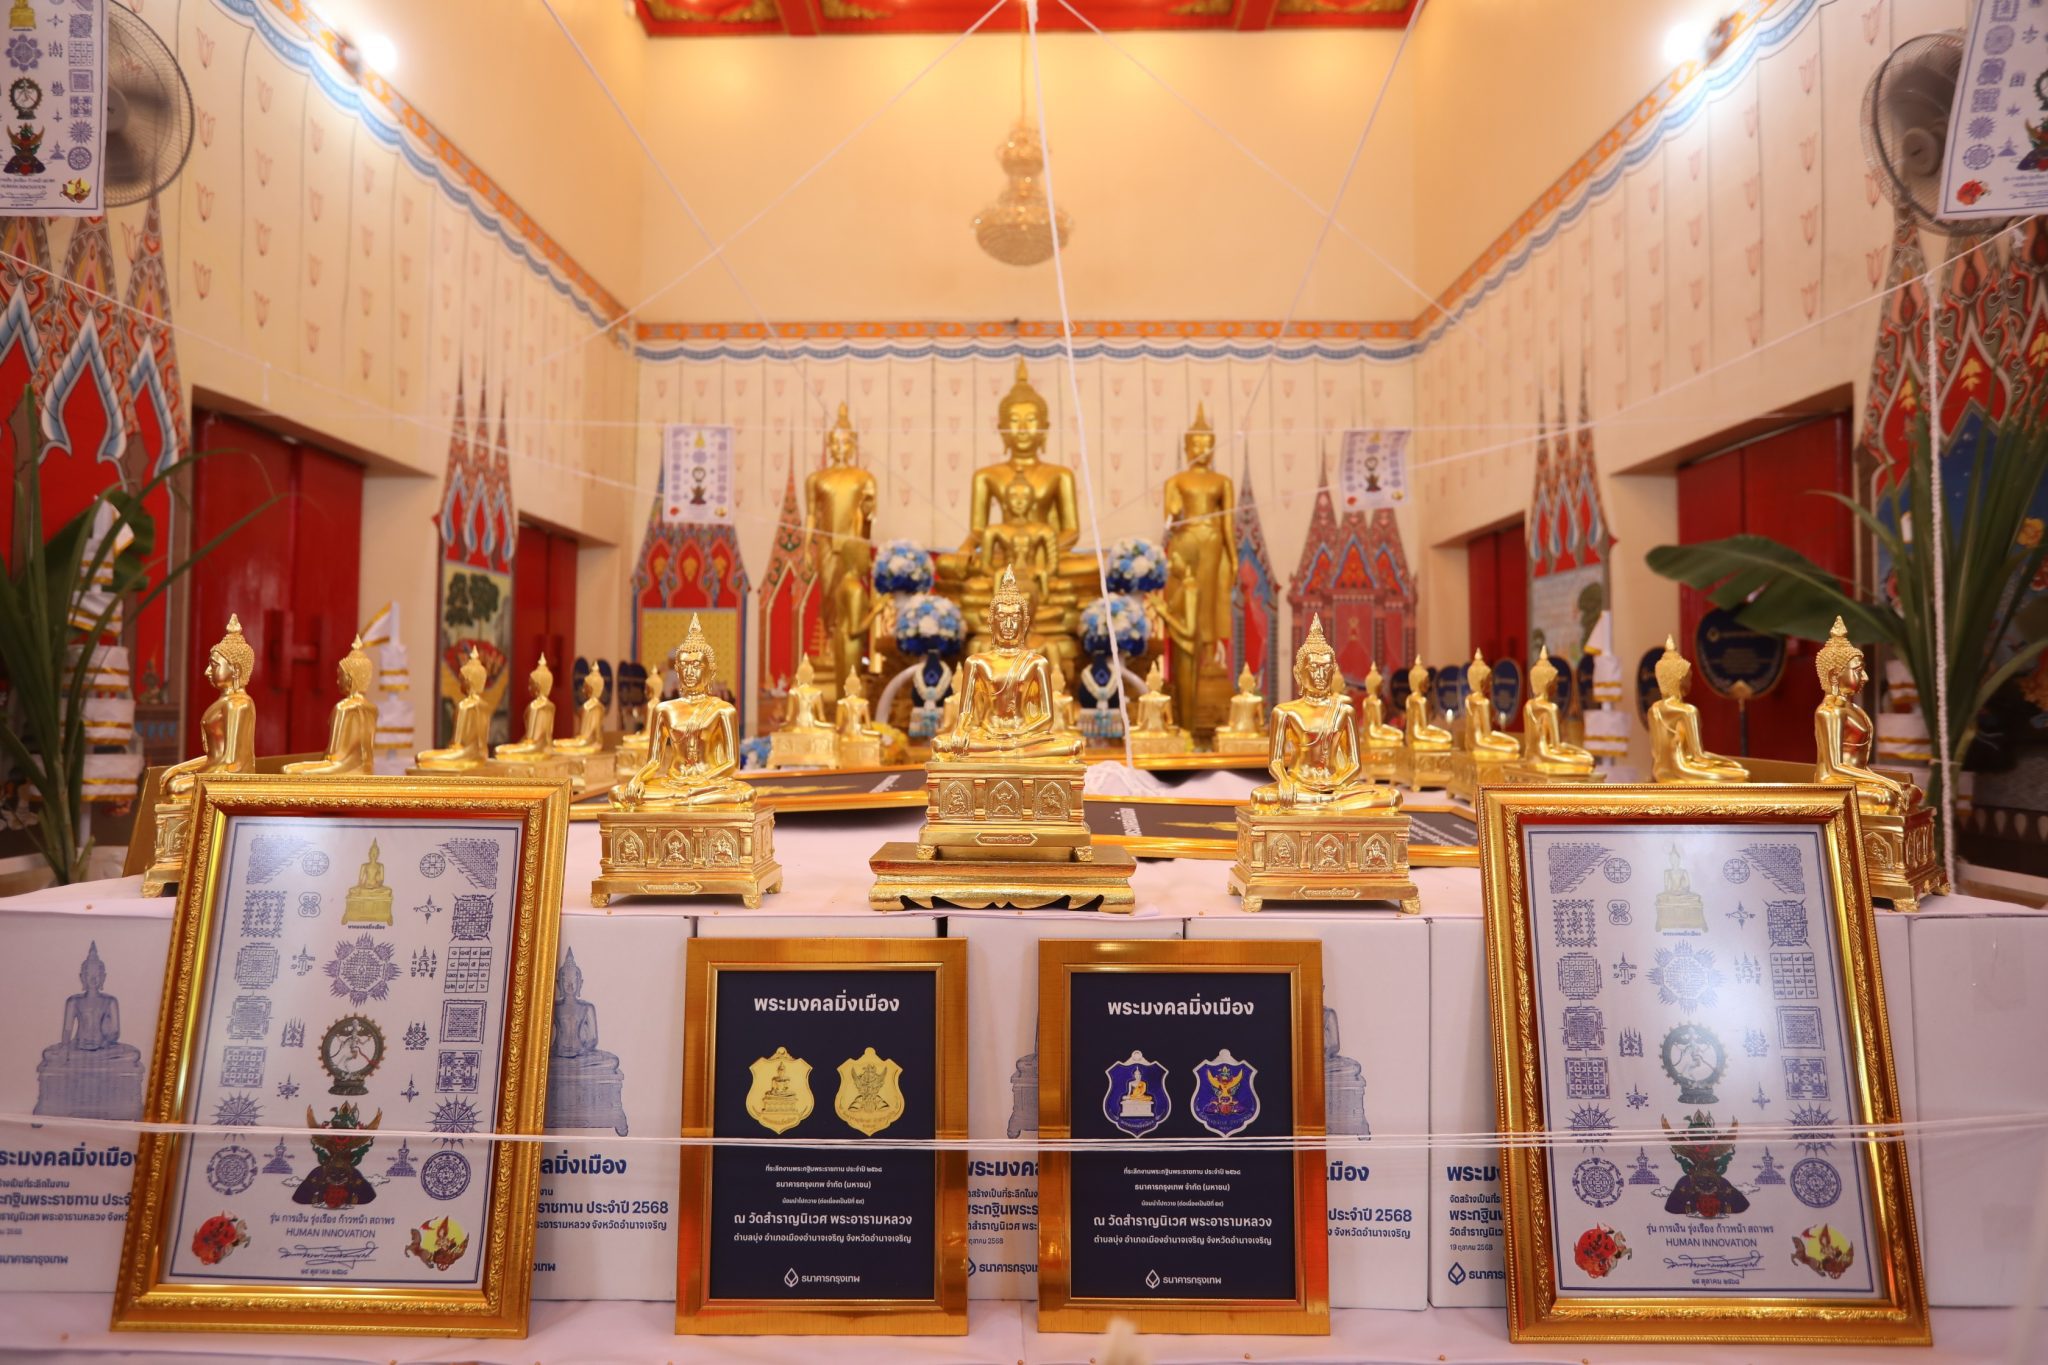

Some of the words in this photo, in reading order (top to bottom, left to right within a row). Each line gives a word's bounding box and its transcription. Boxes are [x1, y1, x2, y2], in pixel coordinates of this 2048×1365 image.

[754, 989, 900, 1012] พระมงคลมิ่งเมือง
[1107, 992, 1255, 1015] พระมงคลมิ่งเมือง
[1326, 1161, 1370, 1181] มือง
[586, 1200, 629, 1214] ประจำปี
[632, 1201, 669, 1214] 2568
[968, 1203, 1038, 1218] ระกฐินพระร
[734, 1213, 746, 1224] ณ
[749, 1211, 827, 1226] วัดสำราญนิเวศ
[830, 1214, 913, 1225] พระอารามหลวง
[1093, 1216, 1105, 1226] ณ
[1108, 1214, 1187, 1228] วัดสำราญนิเวศ
[1190, 1216, 1272, 1227] พระอารามหลวง
[1328, 1207, 1372, 1222] ประจำปี
[1375, 1208, 1412, 1222] 2568
[592, 1220, 667, 1231] จังหวัดอำนาจเจริญ
[286, 1228, 319, 1237] HUMAN
[322, 1229, 375, 1238] INNOVATION
[846, 1232, 912, 1244] จังหวัดอำนาจเจริญ
[1335, 1227, 1411, 1239] จังหวัดอำนาจเจริญ
[1206, 1235, 1272, 1246] จังหวัดอำนาจเจริญ
[1666, 1238, 1700, 1247] HUMAN
[1702, 1238, 1757, 1247] INNOVATION
[801, 1274, 861, 1284] ธนาคารกรุงเทพ
[1162, 1276, 1222, 1285] ธนาคารกรุงเทพ
